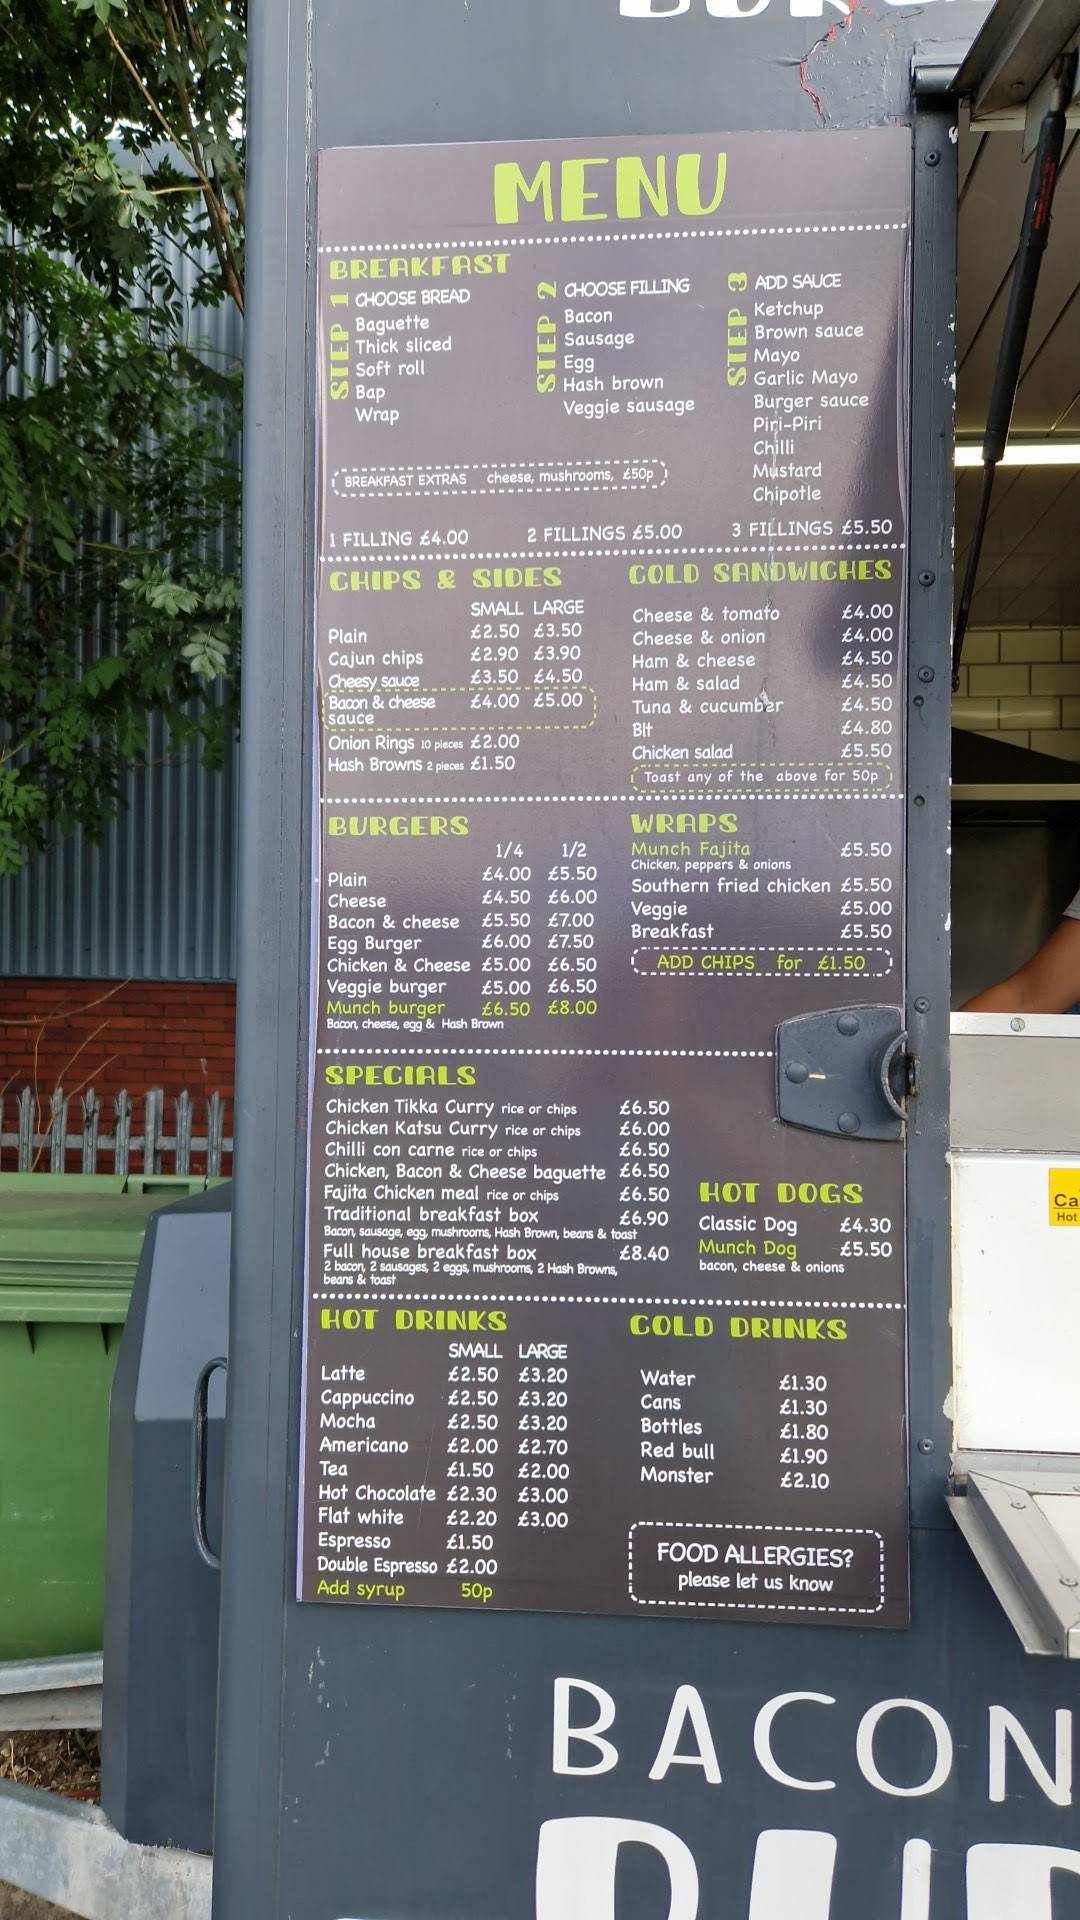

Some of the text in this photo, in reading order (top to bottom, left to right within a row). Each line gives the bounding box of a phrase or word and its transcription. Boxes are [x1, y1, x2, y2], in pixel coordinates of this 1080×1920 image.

[494, 152, 728, 224] MENU
[330, 253, 510, 280] BREAKFAST
[564, 278, 690, 298] CHOOSE FILLING
[755, 273, 842, 290] ADD SAUCE
[355, 288, 471, 307] CHOOSE BREAD
[564, 308, 612, 324] Bacon
[755, 300, 823, 320] Ketchup
[355, 314, 429, 336] Baguette
[727, 272, 747, 386] STEP 3
[330, 293, 349, 400] STEP 1
[537, 281, 557, 393] STEP 2
[565, 332, 635, 349] Sausage
[564, 354, 594, 374] Egg
[754, 348, 800, 366] Mayo
[356, 360, 424, 377] Soft roll
[355, 384, 385, 403] Bap
[564, 375, 664, 392] Hash brown
[355, 407, 399, 426] Wrap
[563, 398, 695, 419] Veggie sausage
[345, 467, 654, 488] BREAKFAST EXTRAS cheese, mushrooms, £50p
[753, 461, 822, 480] Mustard
[528, 524, 682, 543] 2 FILLINGS £5.00
[732, 518, 892, 537] 3 FILLINGS £5.50
[330, 529, 469, 548] 1 FILLING £4.00
[330, 567, 562, 591] CHIPS & SIDES
[629, 560, 891, 584] COLD SANDWICHES
[471, 599, 584, 617] SMALL LARGE
[633, 603, 893, 623] Cheese & tomato £4.00
[328, 622, 582, 644] Plain £2.50 £3.50
[328, 733, 520, 754] Onion Rings 10 pieces £2.00
[644, 769, 878, 785] Toast any of the above for 50p
[329, 816, 469, 836] BURGERS
[631, 813, 738, 833] WRAPS
[496, 841, 587, 859] 1/4 1/2
[632, 841, 892, 858] Munch Fajita £5.50
[631, 858, 791, 873] Chicken, peppers & onions
[657, 954, 865, 970] ADD CHIPS for £1.50
[327, 1000, 597, 1019] Munch burger £6.50 £8.00
[327, 1018, 504, 1032] Bacon, cheese, egg & Hash Brown
[325, 1065, 476, 1085] SPECIALS
[326, 1098, 670, 1118] Chicken Tikka Curry rice or chips £6.50
[700, 1182, 863, 1204] HOT DOGS
[324, 1205, 669, 1226] Traditional breakfast box £6.90
[1057, 1212, 1078, 1222] Hot
[324, 1225, 638, 1240] Bacon, sausage, egg, mushrooms, Hash Brown, beans & toast
[699, 1215, 891, 1237] Classic Dog £4.30
[699, 1259, 845, 1273] bacon, cheese & onions
[321, 1309, 507, 1331] HOT DRINKS
[630, 1315, 847, 1340] COLD DRINKS
[449, 1342, 568, 1359] SMALL LARGE
[322, 1365, 568, 1383] Latte £2.50 £3.20
[640, 1369, 827, 1392] Water £1.30
[641, 1441, 828, 1465] Red bull £1.90
[319, 1484, 568, 1504] Hot Chocolate £2.30 £3.00
[657, 1542, 854, 1568] FOOD ALLERGIES?
[679, 1570, 834, 1592] please let us know
[553, 1677, 1072, 1806] BACON
